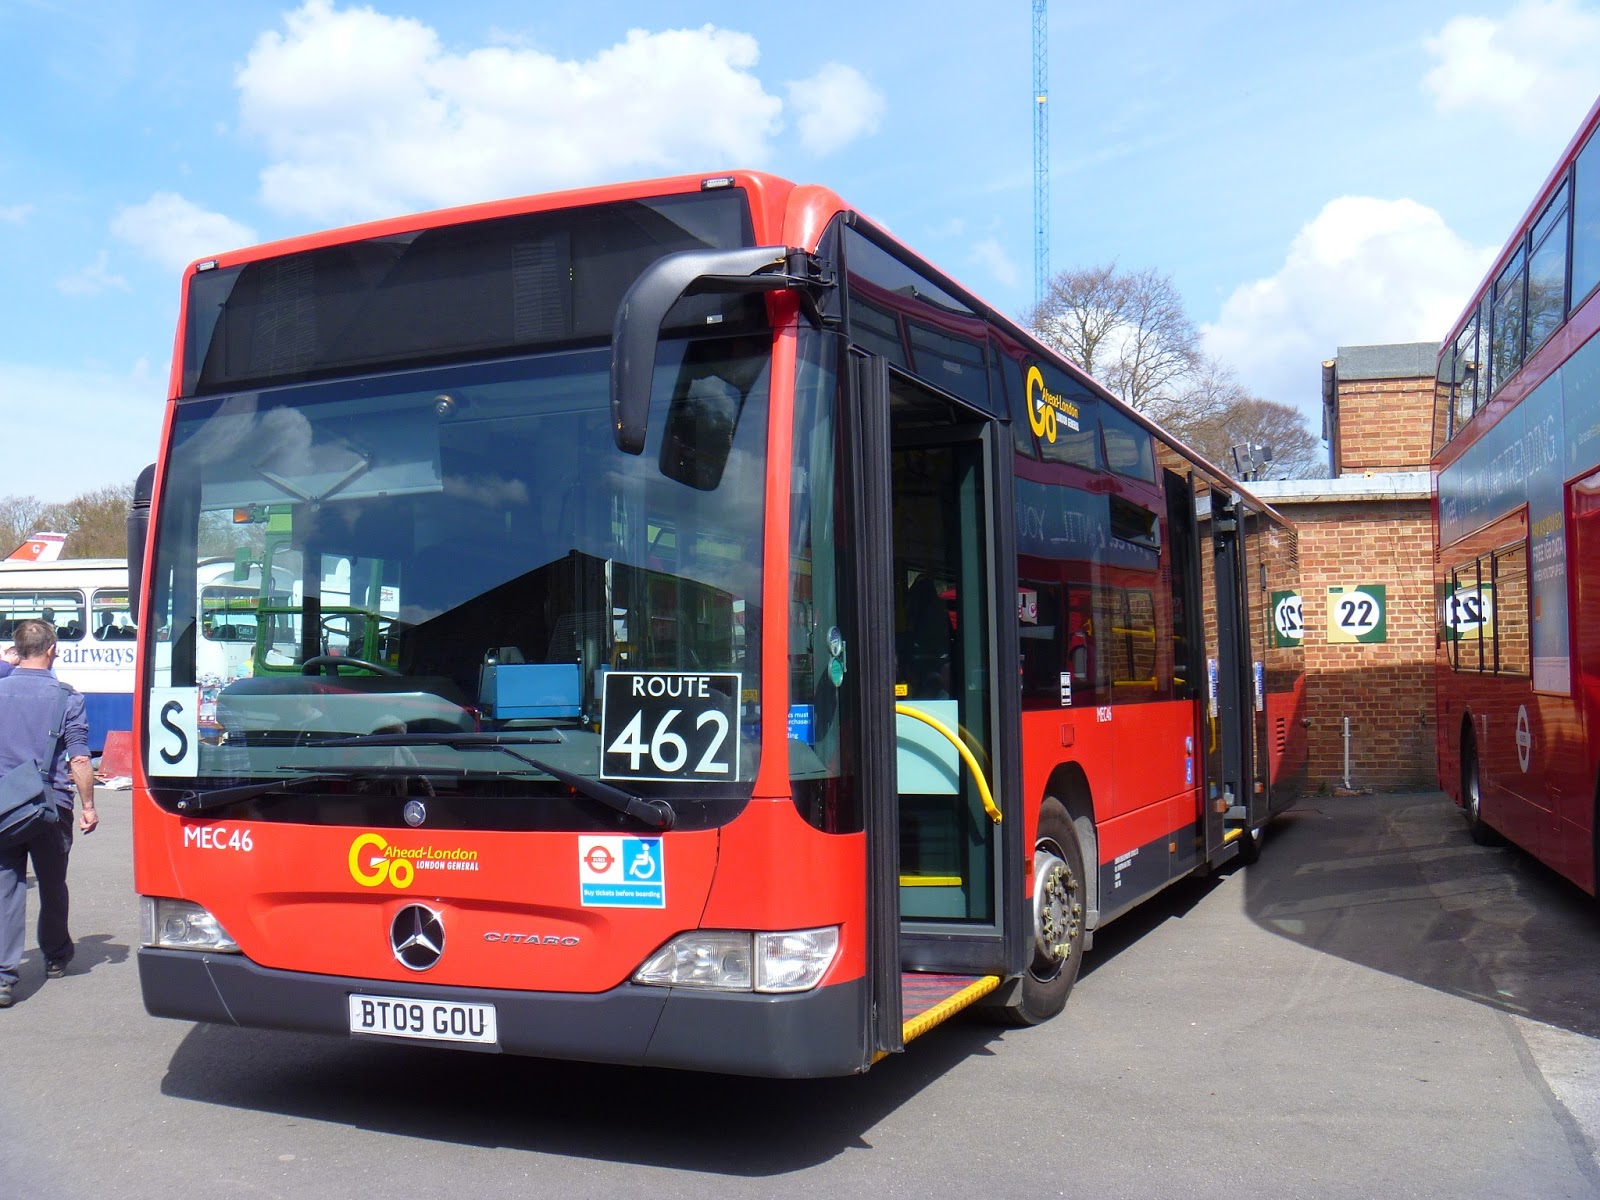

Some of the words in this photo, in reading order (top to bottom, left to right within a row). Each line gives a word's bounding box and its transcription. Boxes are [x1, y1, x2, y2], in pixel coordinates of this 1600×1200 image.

[1026, 365, 1057, 444] Go
[1340, 600, 1373, 627] 22
[62, 643, 134, 666] airways
[632, 676, 711, 698] ROUTE
[159, 699, 188, 765] S
[606, 709, 730, 774] 462
[183, 826, 254, 853] MEC46
[348, 832, 415, 889] Go
[383, 845, 478, 861] Ahead-London
[416, 860, 445, 870] LONDON
[446, 861, 479, 871] GENERAL
[583, 889, 595, 897] Buy
[595, 889, 615, 897] tickets
[635, 890, 661, 899] boarding
[483, 931, 580, 947] CITARO
[361, 1000, 425, 1033] BT09
[432, 1006, 485, 1037] GOU
